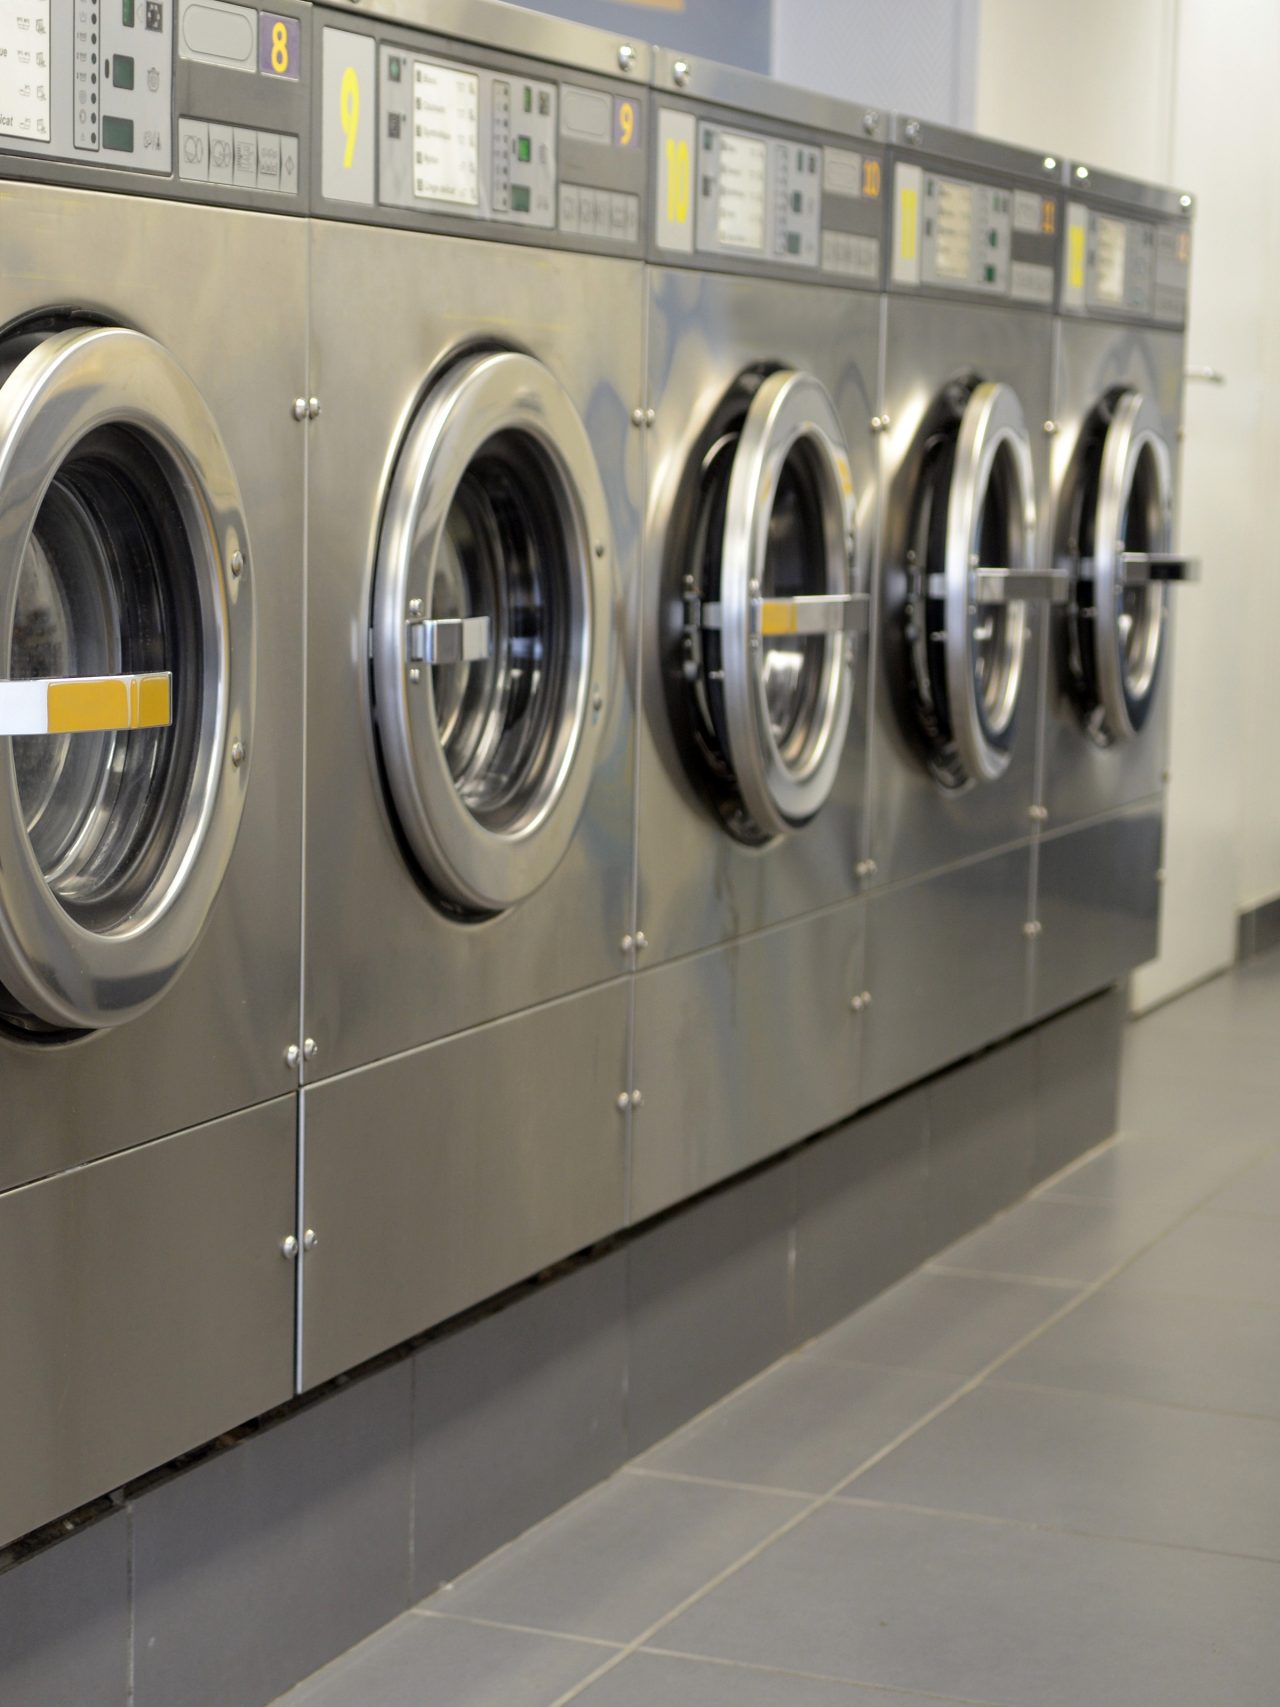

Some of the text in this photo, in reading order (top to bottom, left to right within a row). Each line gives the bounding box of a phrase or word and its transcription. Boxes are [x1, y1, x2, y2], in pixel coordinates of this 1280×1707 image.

[271, 21, 289, 74] 8
[340, 67, 360, 169] 9
[619, 102, 635, 146] 9
[666, 138, 690, 224] 10
[863, 159, 881, 198] 10
